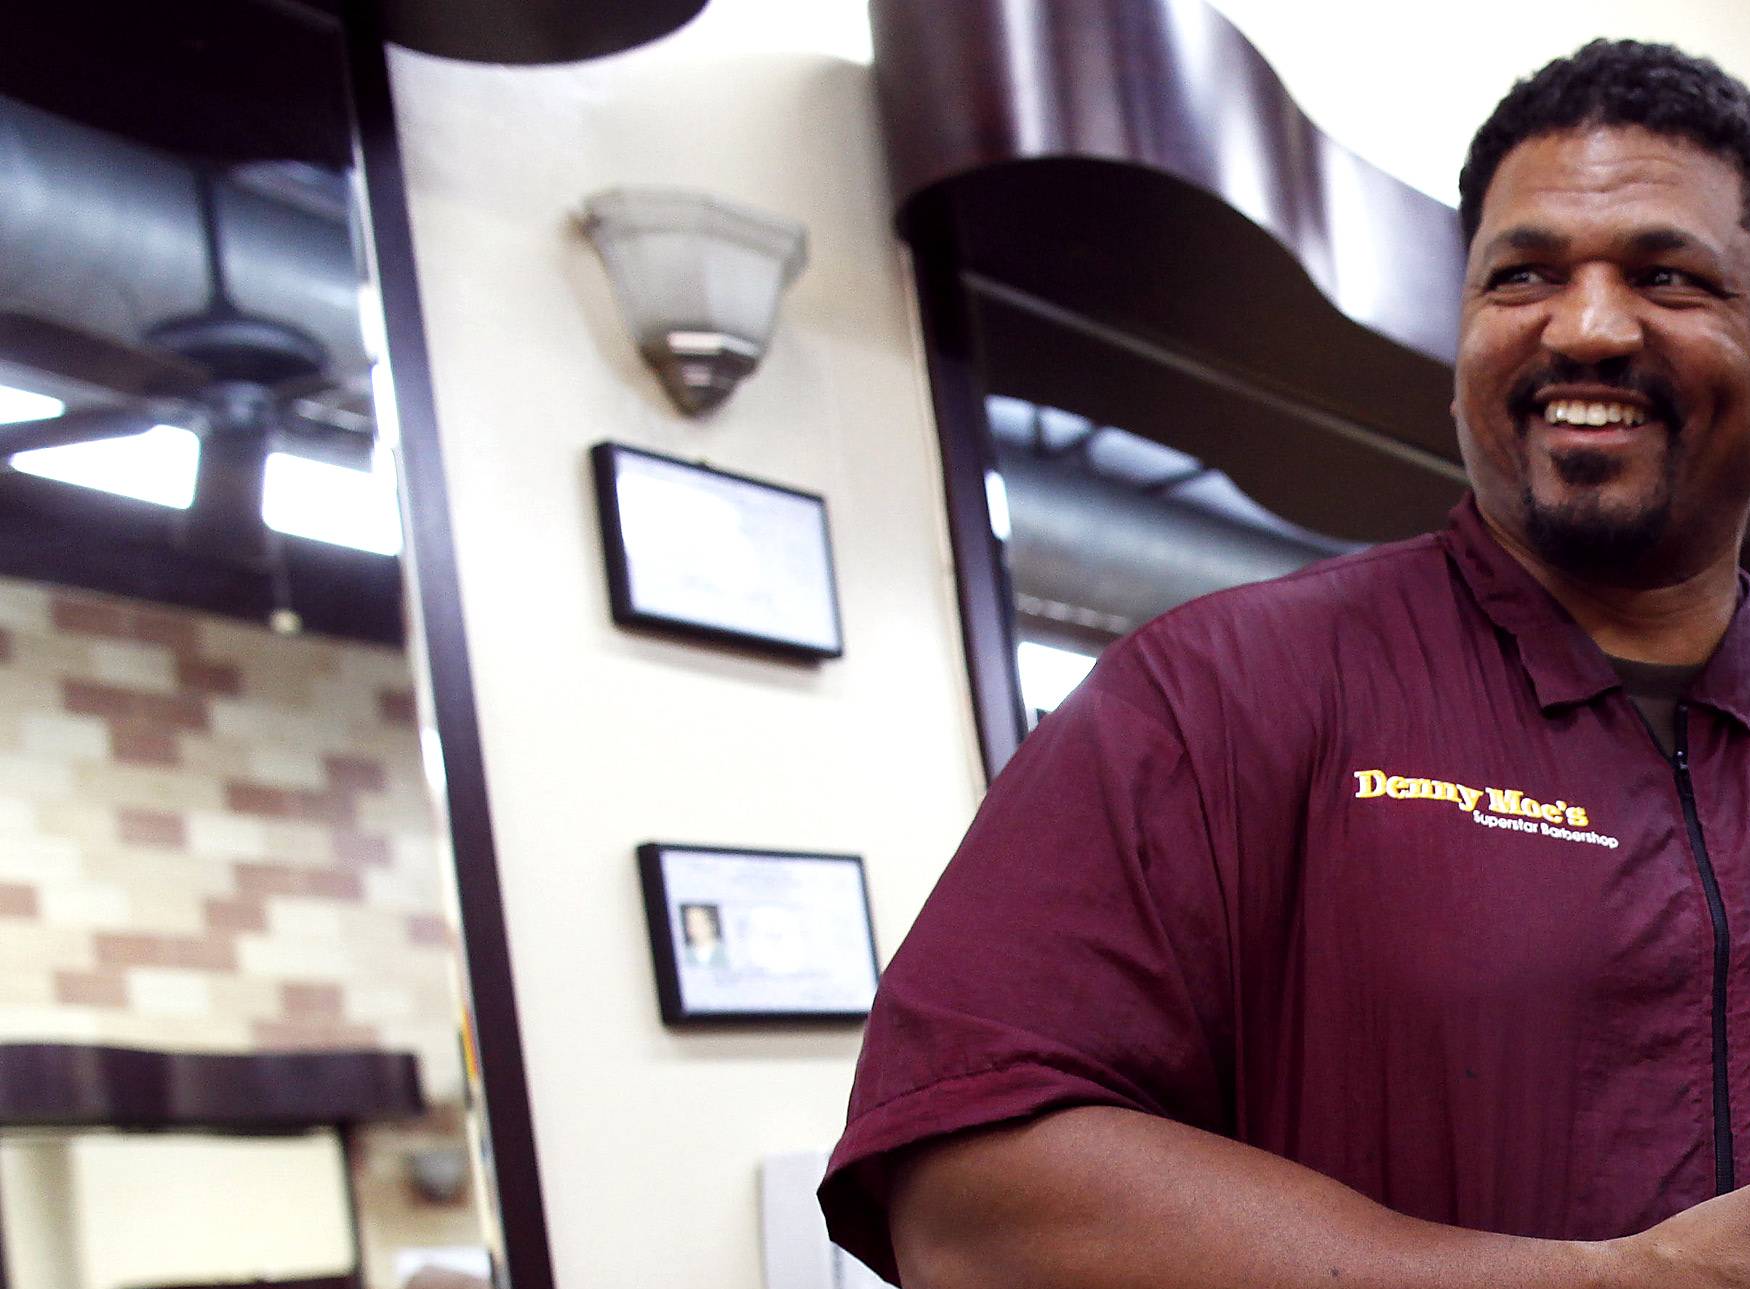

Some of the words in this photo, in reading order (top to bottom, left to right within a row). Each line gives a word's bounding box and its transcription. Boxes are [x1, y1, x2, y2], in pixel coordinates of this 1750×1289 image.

[1354, 769, 1483, 812] Denny
[1485, 787, 1588, 827] Moe's
[1473, 809, 1538, 834] Superstar
[1541, 822, 1619, 849] Barbershop
